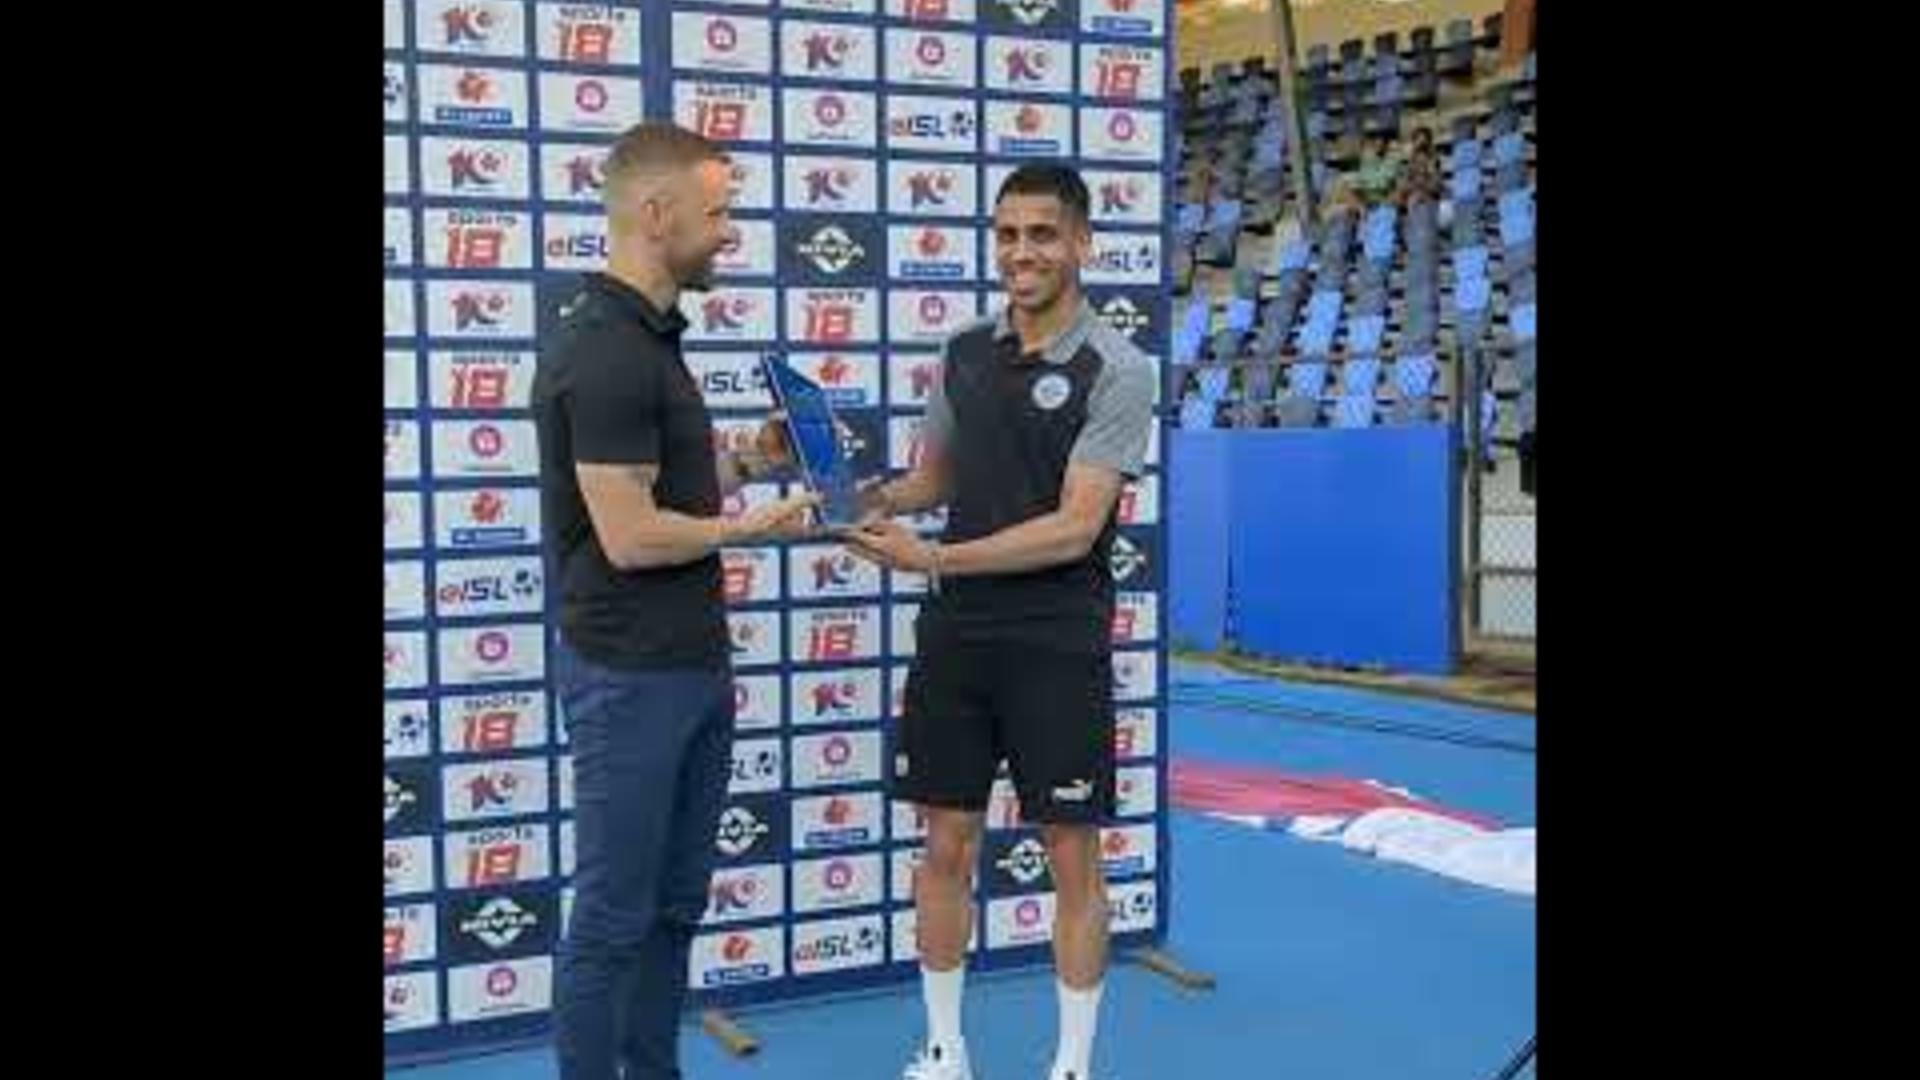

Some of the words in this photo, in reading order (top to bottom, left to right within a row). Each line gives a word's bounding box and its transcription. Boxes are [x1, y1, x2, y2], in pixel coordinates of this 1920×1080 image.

[559, 23, 613, 64] 18
[446, 229, 505, 269] 18
[450, 367, 509, 409] 18
[705, 371, 746, 392] ISL
[462, 711, 519, 751] 18
[467, 844, 521, 886] 18
